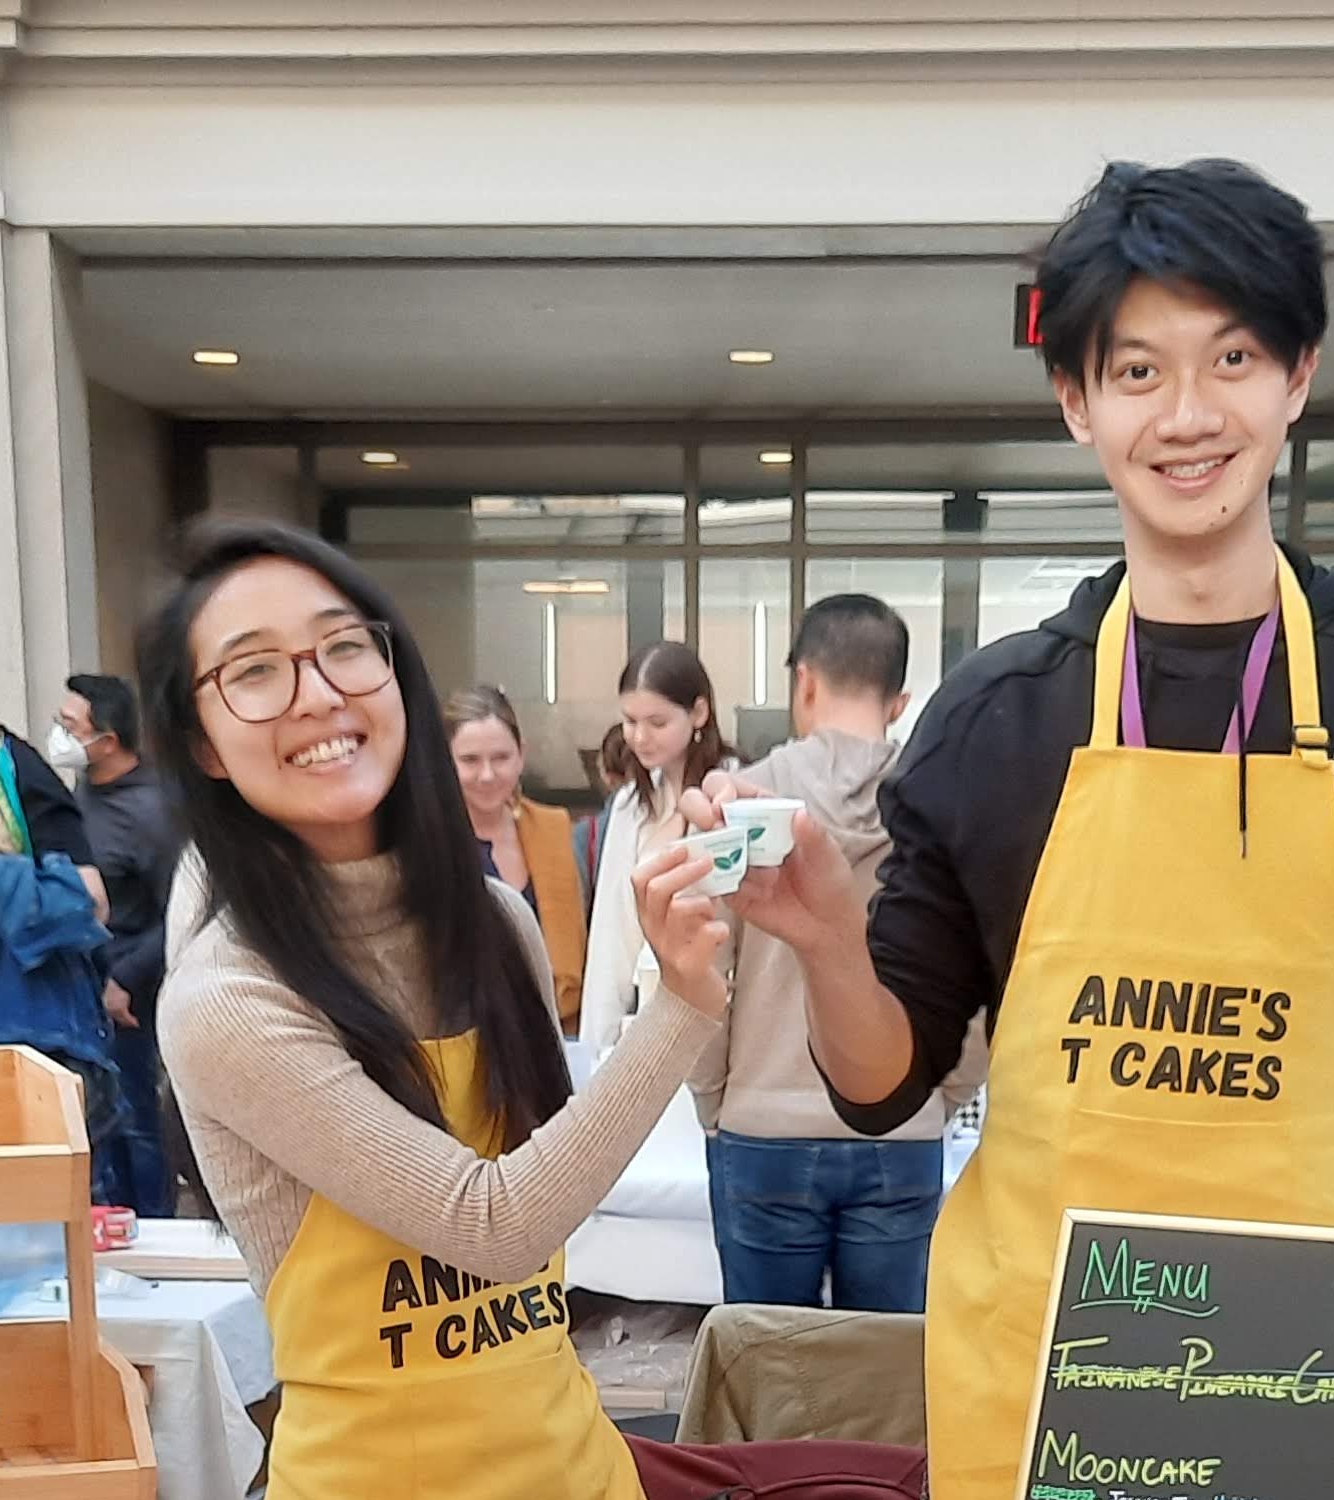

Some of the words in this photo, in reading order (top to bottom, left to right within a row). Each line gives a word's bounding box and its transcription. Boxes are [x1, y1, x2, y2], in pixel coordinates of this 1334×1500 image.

[1068, 975, 1291, 1042] ANNIE'S
[1061, 1038, 1091, 1083] T
[1110, 1042, 1283, 1101] CAKES
[1080, 1239, 1209, 1302] MENU
[379, 1323, 412, 1368] T
[435, 1281, 565, 1359] CAKES
